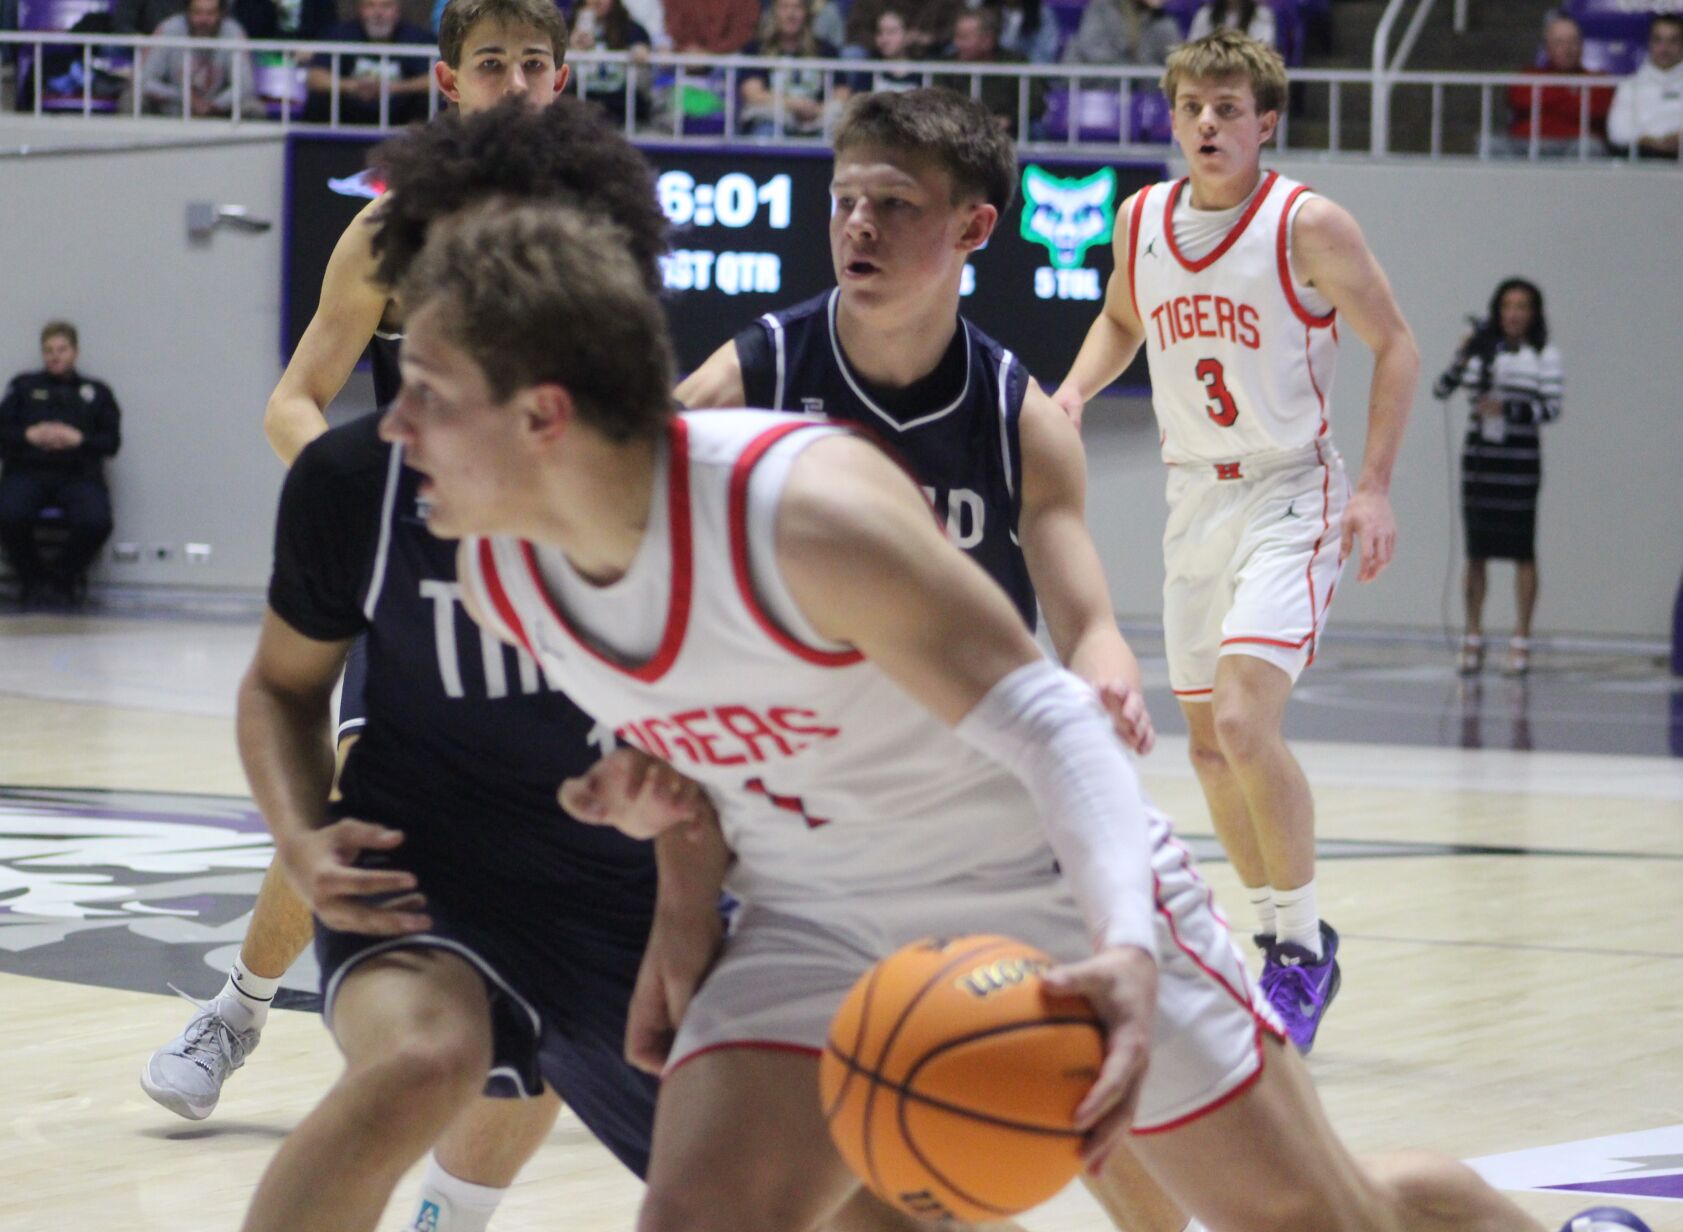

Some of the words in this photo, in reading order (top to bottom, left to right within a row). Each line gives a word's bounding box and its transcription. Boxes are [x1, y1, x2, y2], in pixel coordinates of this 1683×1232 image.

[656, 169, 792, 229] 6:01
[715, 250, 781, 295] QTR
[1150, 295, 1261, 351] TIGERS
[1195, 358, 1239, 427] 3
[1214, 462, 1244, 480] H
[614, 704, 841, 766] IGERS
